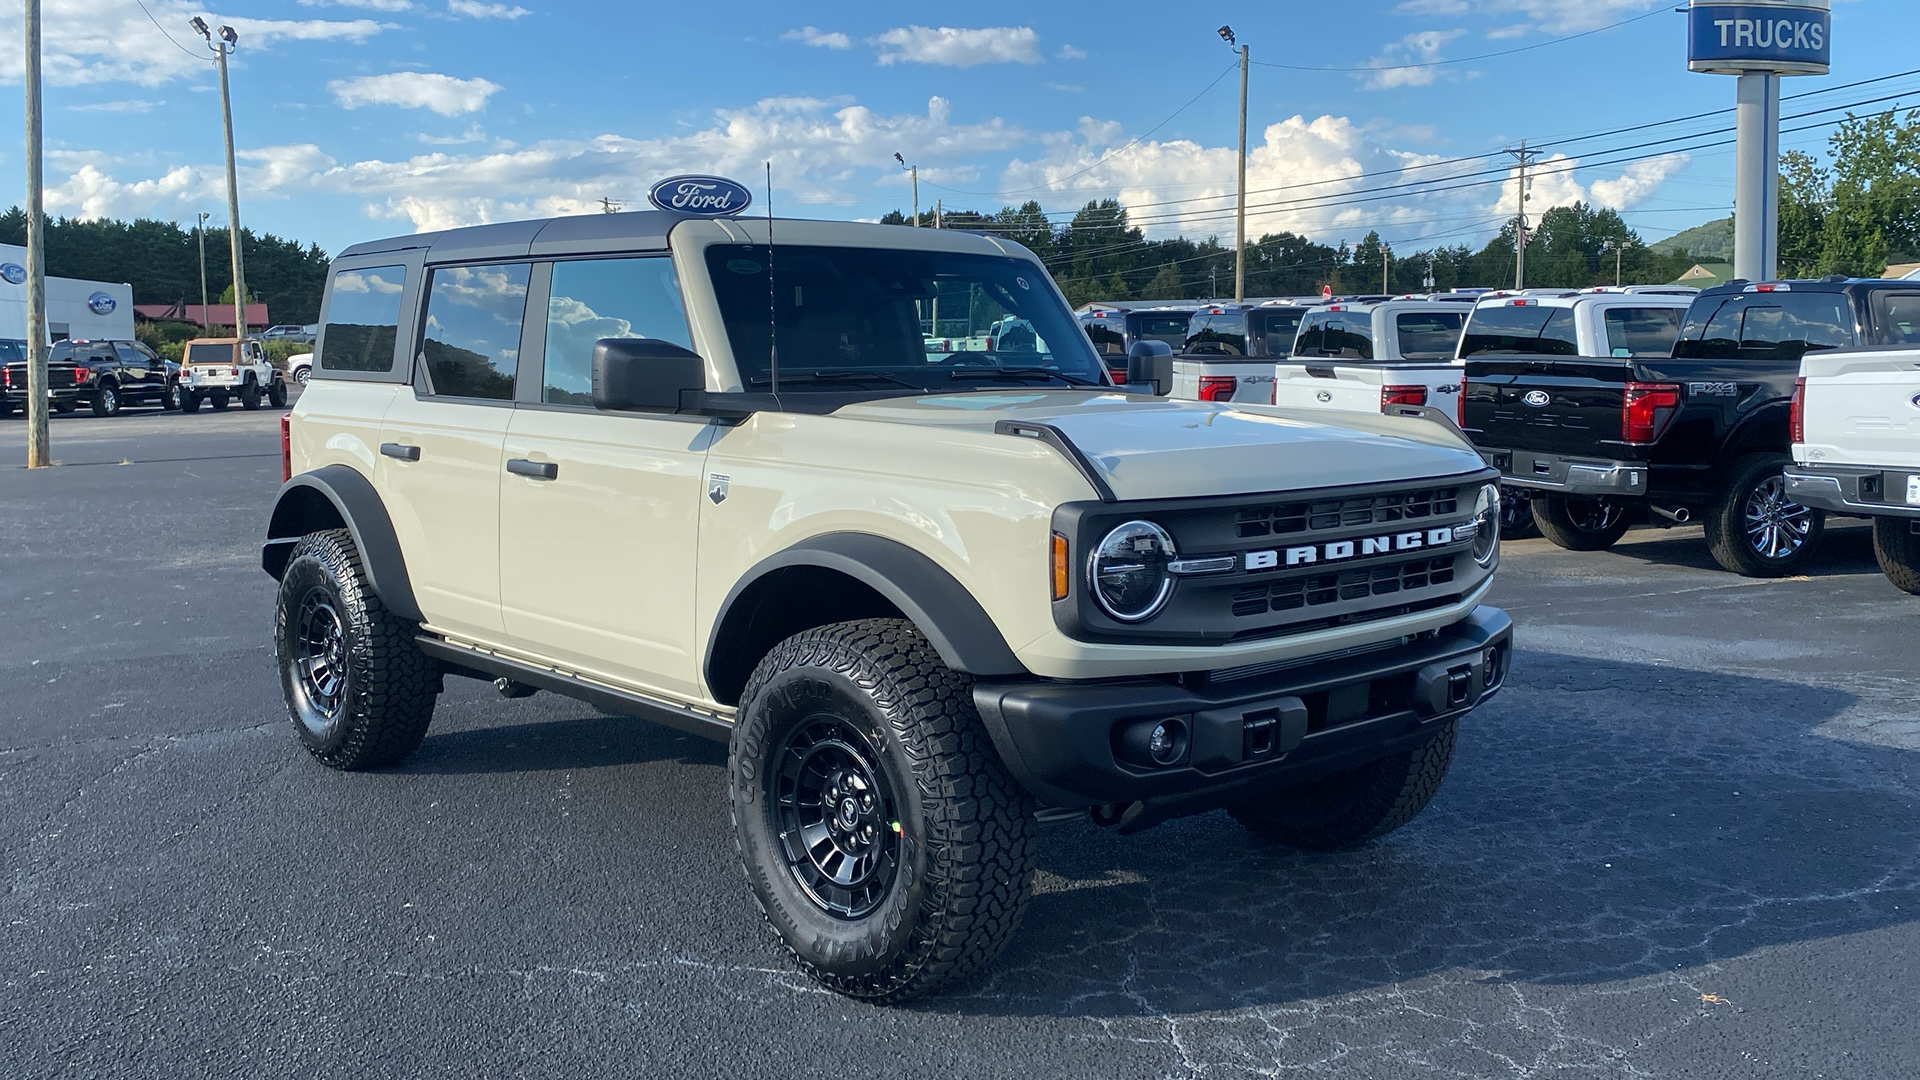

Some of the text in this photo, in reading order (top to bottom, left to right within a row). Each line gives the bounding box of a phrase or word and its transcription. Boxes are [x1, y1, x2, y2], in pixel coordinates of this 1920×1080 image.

[1714, 19, 1824, 50] TRUCKS
[672, 182, 732, 208] Ford
[1689, 382, 1737, 396] FX4
[1245, 527, 1452, 570] BRONCO
